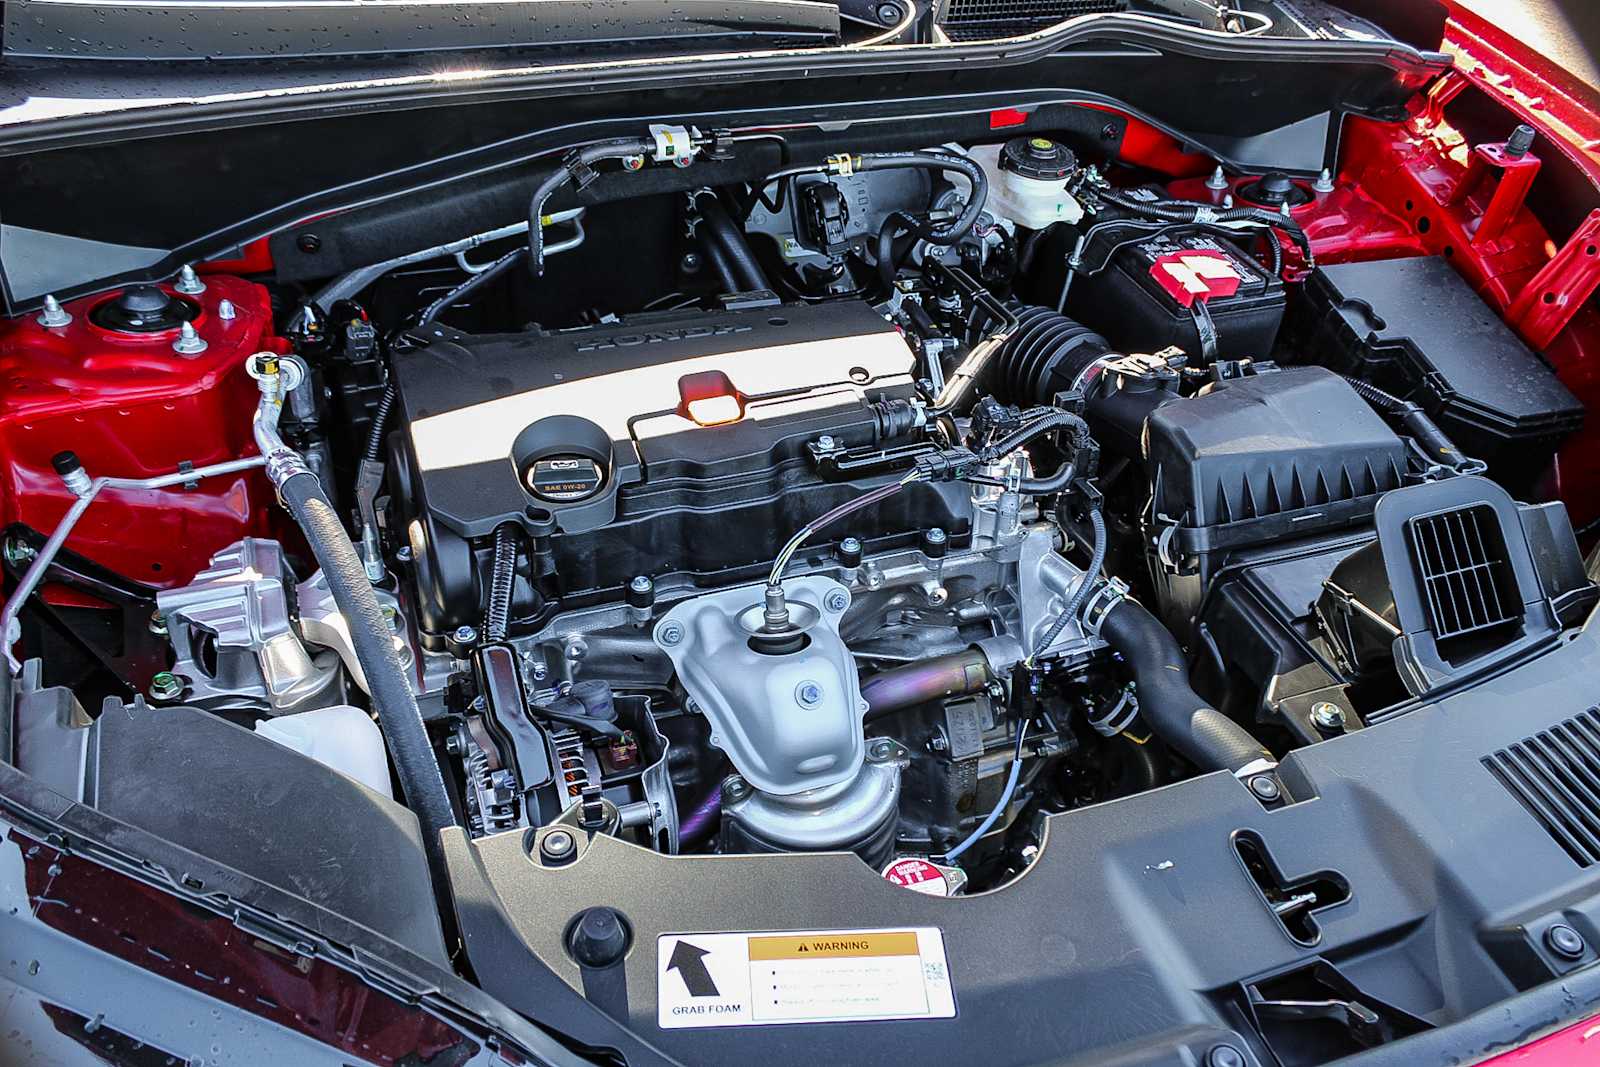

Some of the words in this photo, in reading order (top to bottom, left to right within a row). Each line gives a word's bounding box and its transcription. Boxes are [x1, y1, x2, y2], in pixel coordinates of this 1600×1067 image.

[544, 484, 561, 492] SAE
[562, 482, 586, 491] 0W-20
[812, 940, 870, 952] WARNING
[672, 1004, 706, 1016] GRAB
[708, 1003, 742, 1015] FOAM
